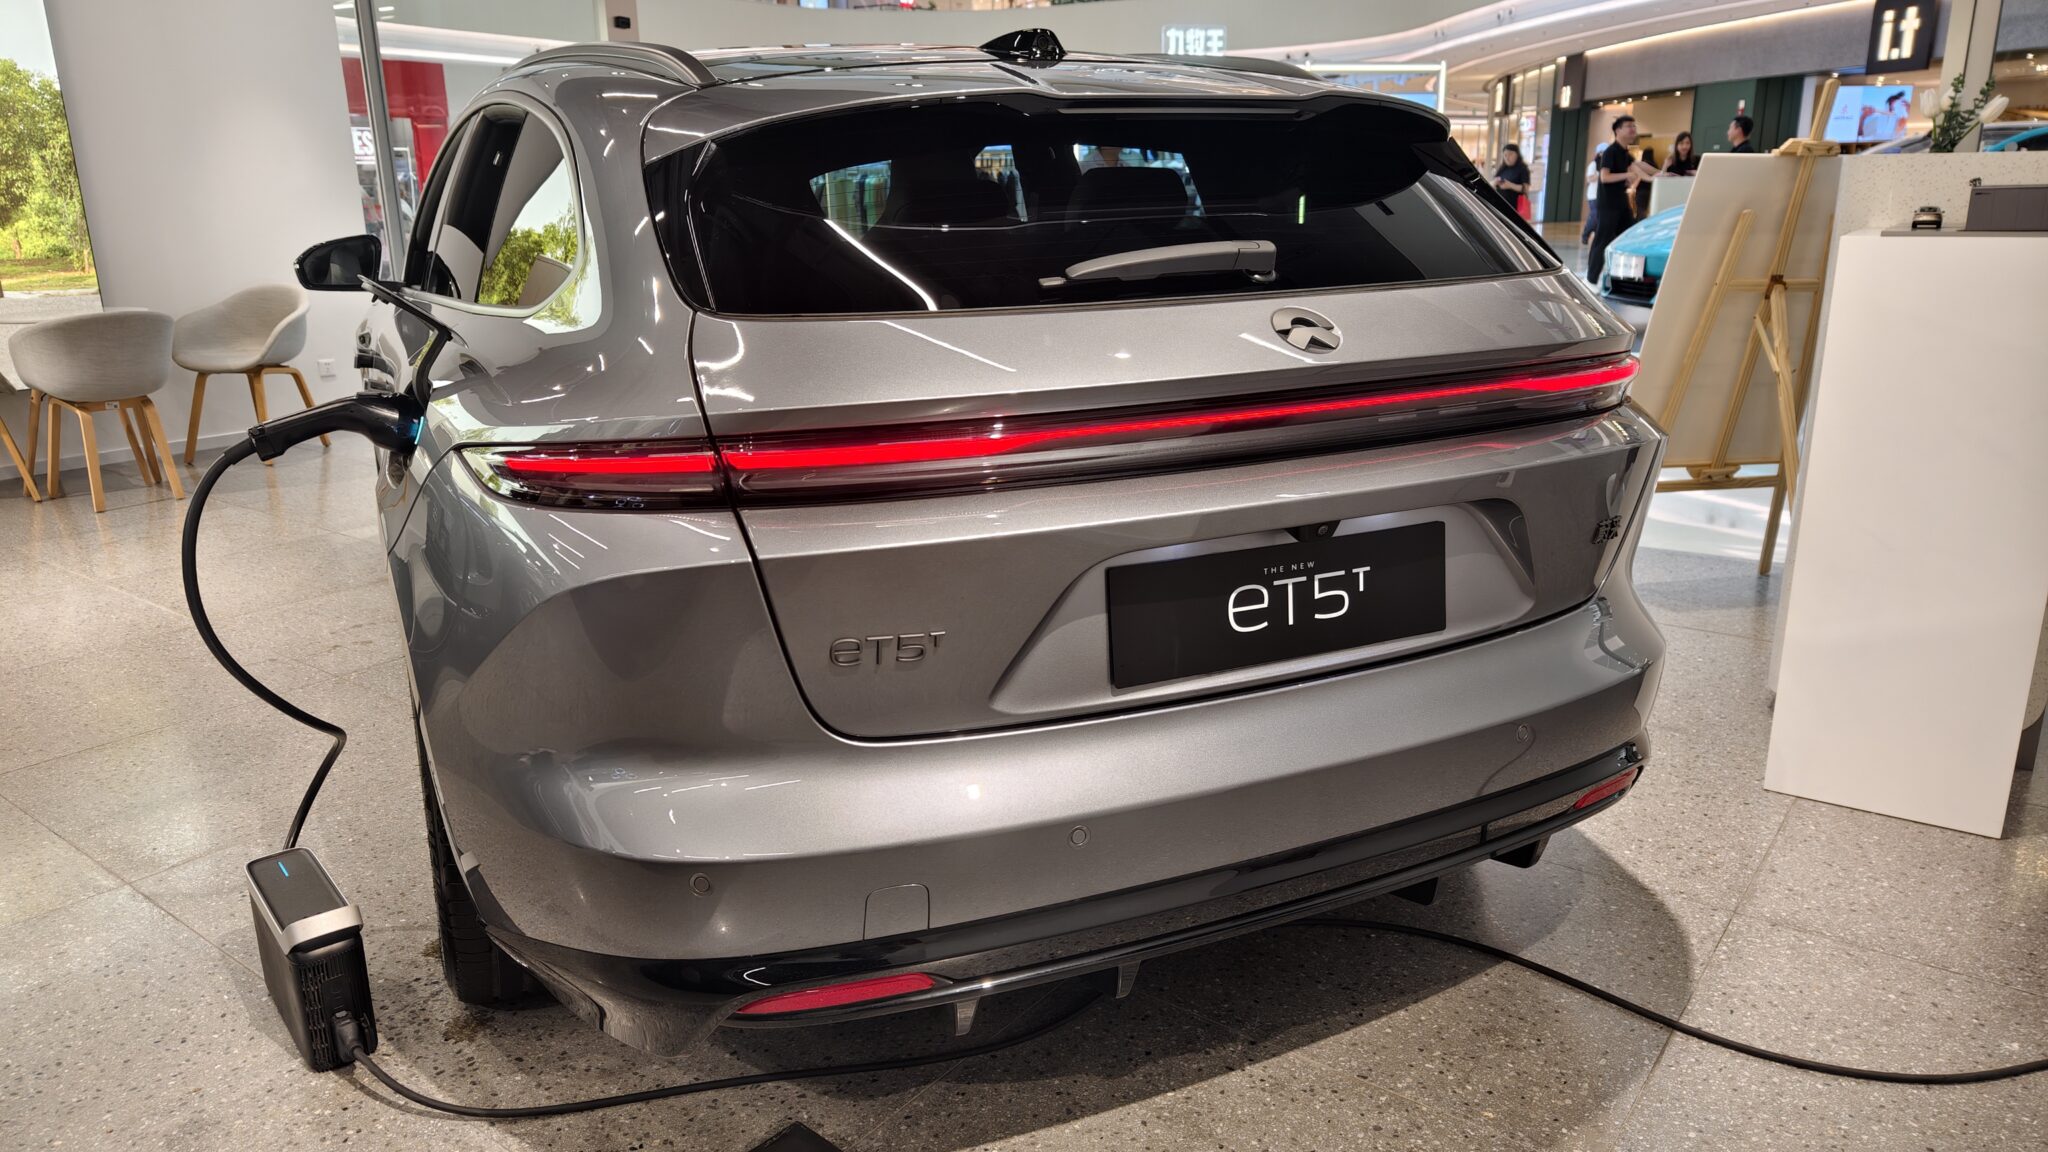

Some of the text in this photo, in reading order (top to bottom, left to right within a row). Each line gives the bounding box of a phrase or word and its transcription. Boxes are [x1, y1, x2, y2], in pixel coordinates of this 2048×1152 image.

[1878, 6, 1920, 61] i.t
[1263, 561, 1315, 575] THE NEW
